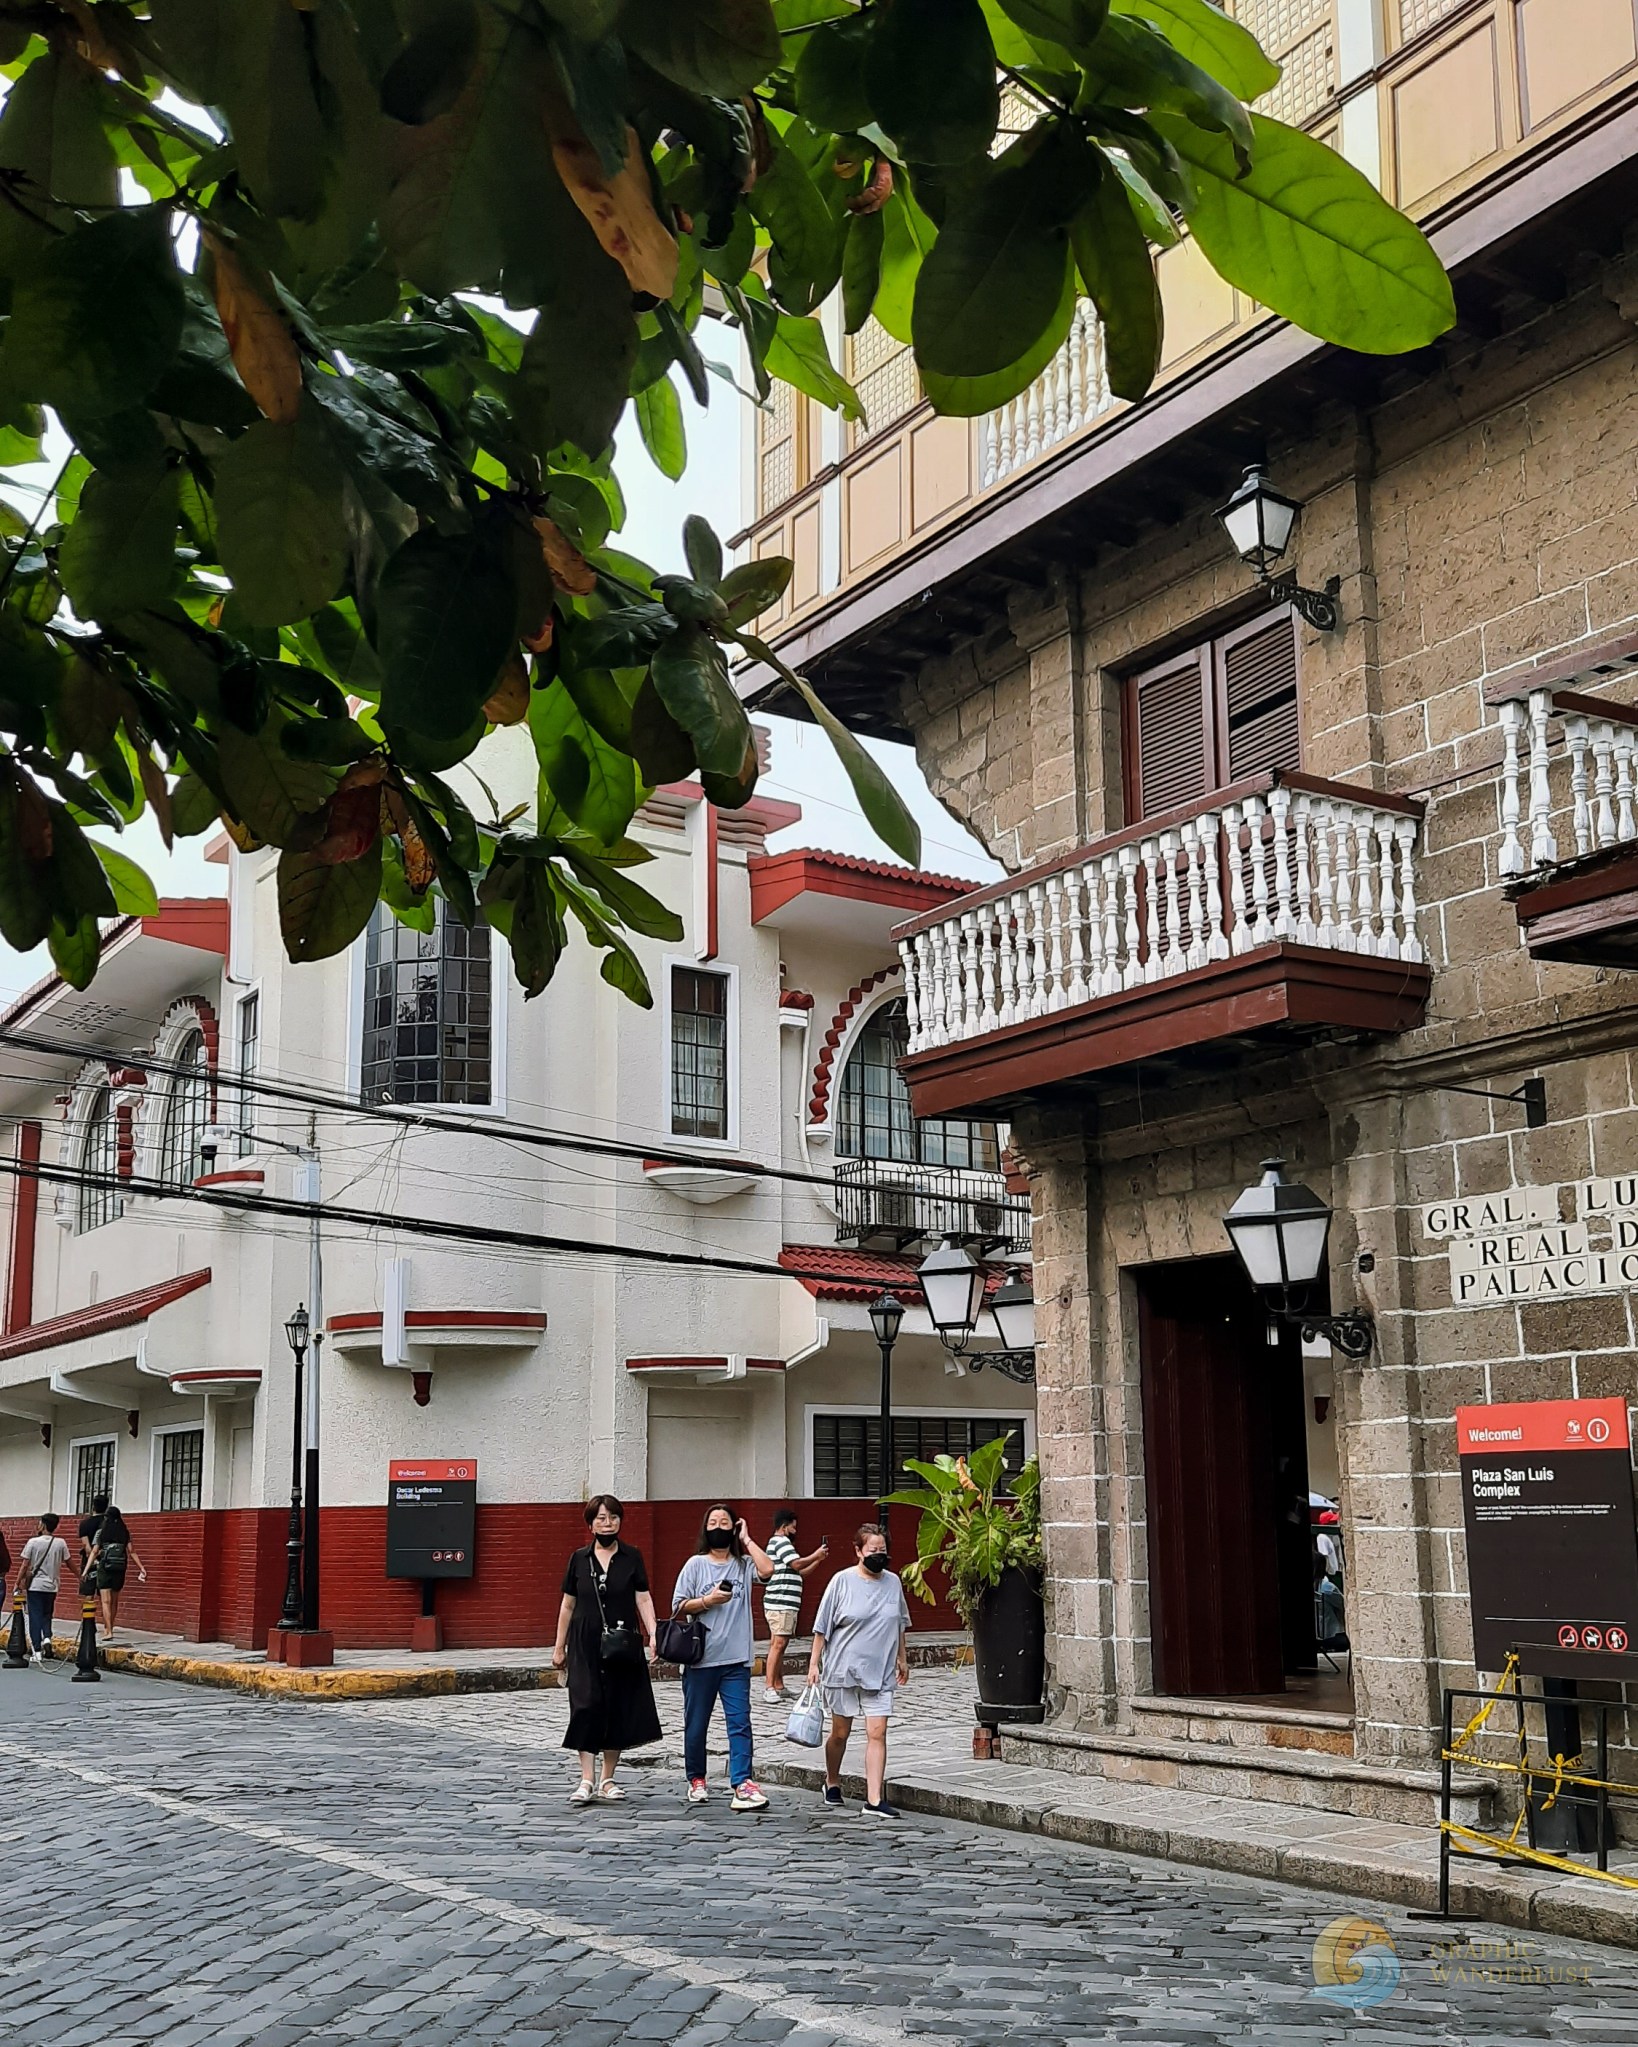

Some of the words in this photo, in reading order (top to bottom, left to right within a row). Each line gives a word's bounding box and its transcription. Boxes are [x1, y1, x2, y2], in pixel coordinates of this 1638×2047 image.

[1427, 1197, 1536, 1233] GRAL.
[1468, 1426, 1522, 1442] Welcome!
[1472, 1469, 1502, 1482] Plaza
[1503, 1468, 1526, 1481] San
[1528, 1467, 1555, 1481] Luis
[1473, 1482, 1521, 1500] Complex
